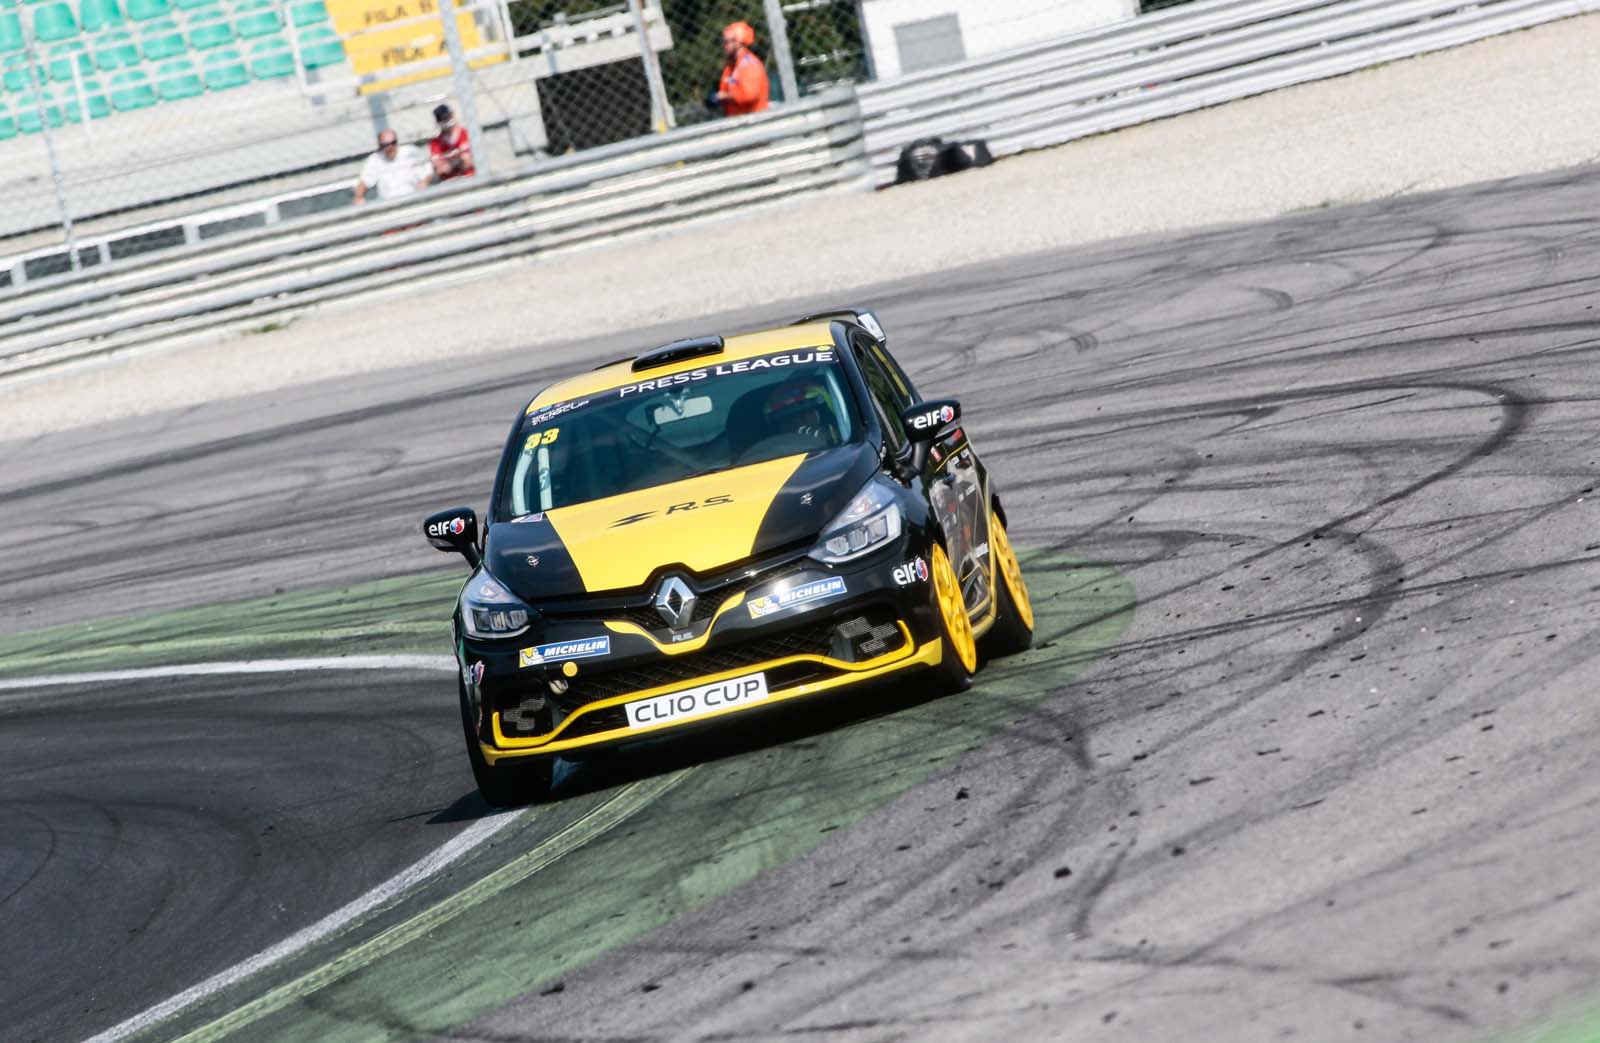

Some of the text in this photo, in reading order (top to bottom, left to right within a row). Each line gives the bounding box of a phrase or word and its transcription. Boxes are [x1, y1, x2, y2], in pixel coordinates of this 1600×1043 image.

[365, 5, 408, 24] FILA
[382, 46, 424, 66] FILA
[619, 351, 833, 398] PRESS LEAGUE
[913, 410, 941, 429] elf
[428, 520, 451, 536] elf
[893, 562, 917, 585] elf
[543, 640, 607, 657] MICHELIN
[635, 679, 760, 722] CLIO CUP
